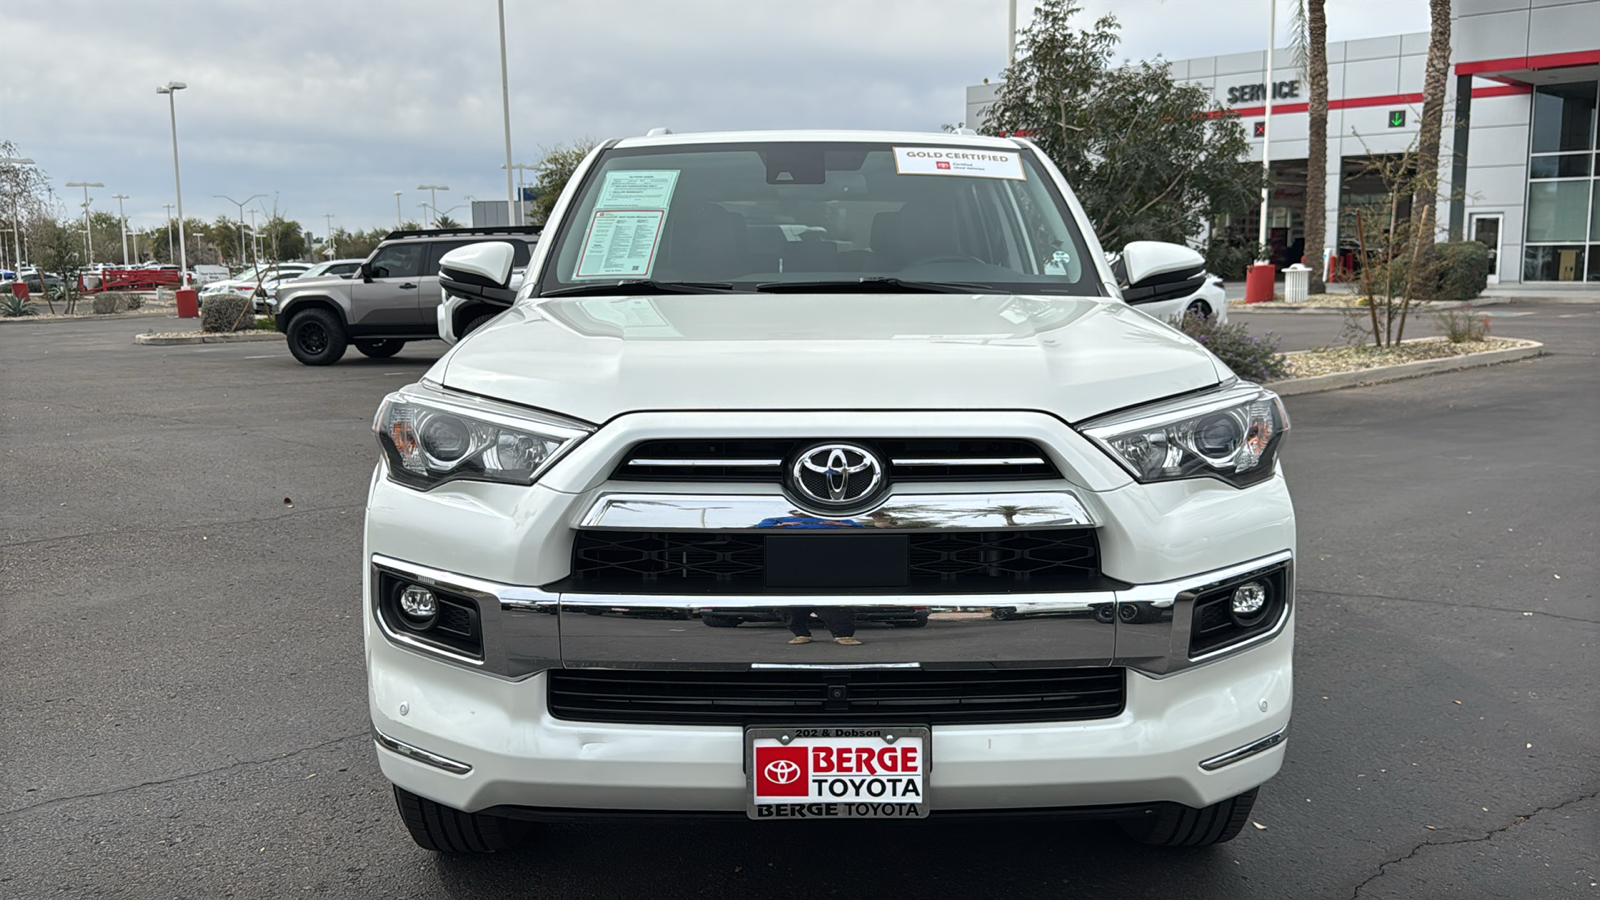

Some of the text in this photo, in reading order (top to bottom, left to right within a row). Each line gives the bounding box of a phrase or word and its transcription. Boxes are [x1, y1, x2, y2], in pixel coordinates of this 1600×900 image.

[1227, 80, 1299, 104] SERVICE
[945, 152, 1008, 162] CERTIFIED
[795, 729, 881, 738] 202 & Dobson
[812, 746, 918, 775] BERGE
[812, 778, 920, 797] TOYOTA
[757, 803, 919, 817] BERGE TOYOTA
